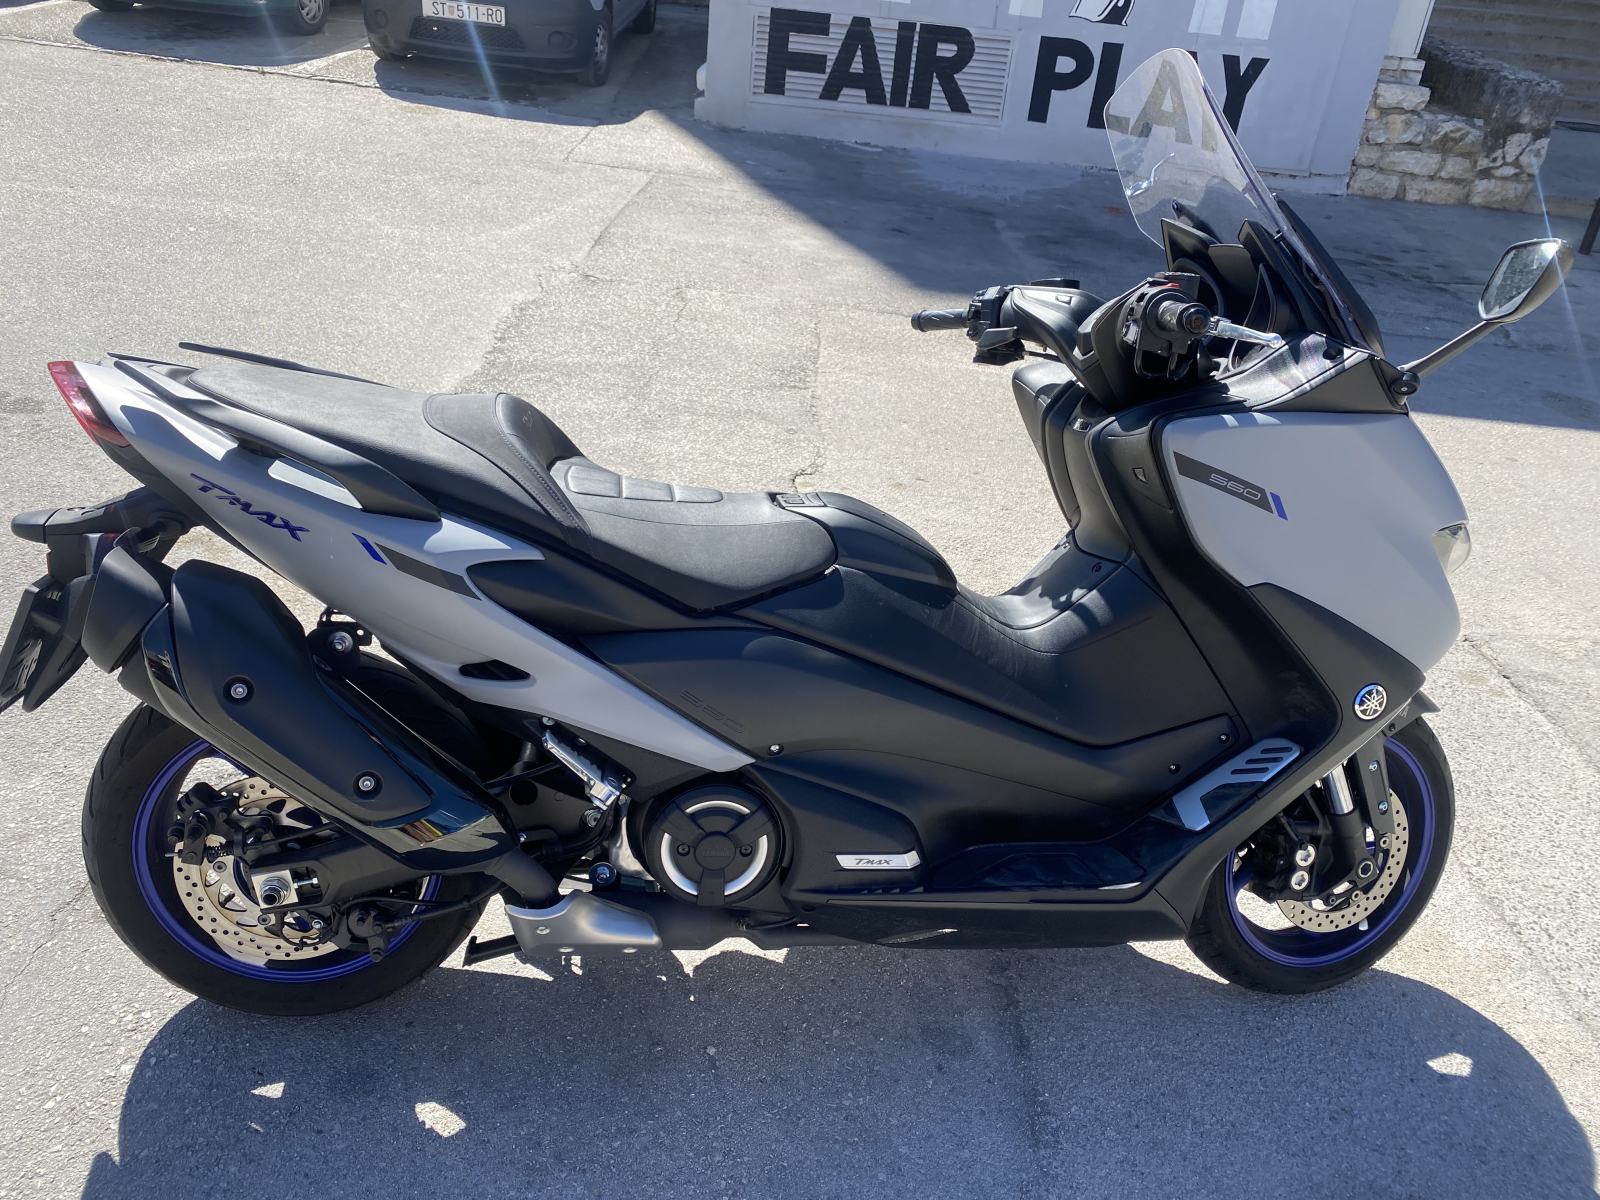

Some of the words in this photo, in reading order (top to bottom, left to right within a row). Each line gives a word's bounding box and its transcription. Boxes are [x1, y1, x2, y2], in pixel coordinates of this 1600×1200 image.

[432, 1, 447, 16] ST
[764, 7, 976, 114] FAIR
[1027, 35, 1270, 145] PLAY
[1209, 473, 1261, 501] 560
[190, 472, 310, 542] TMAX
[854, 858, 893, 866] TMAX
